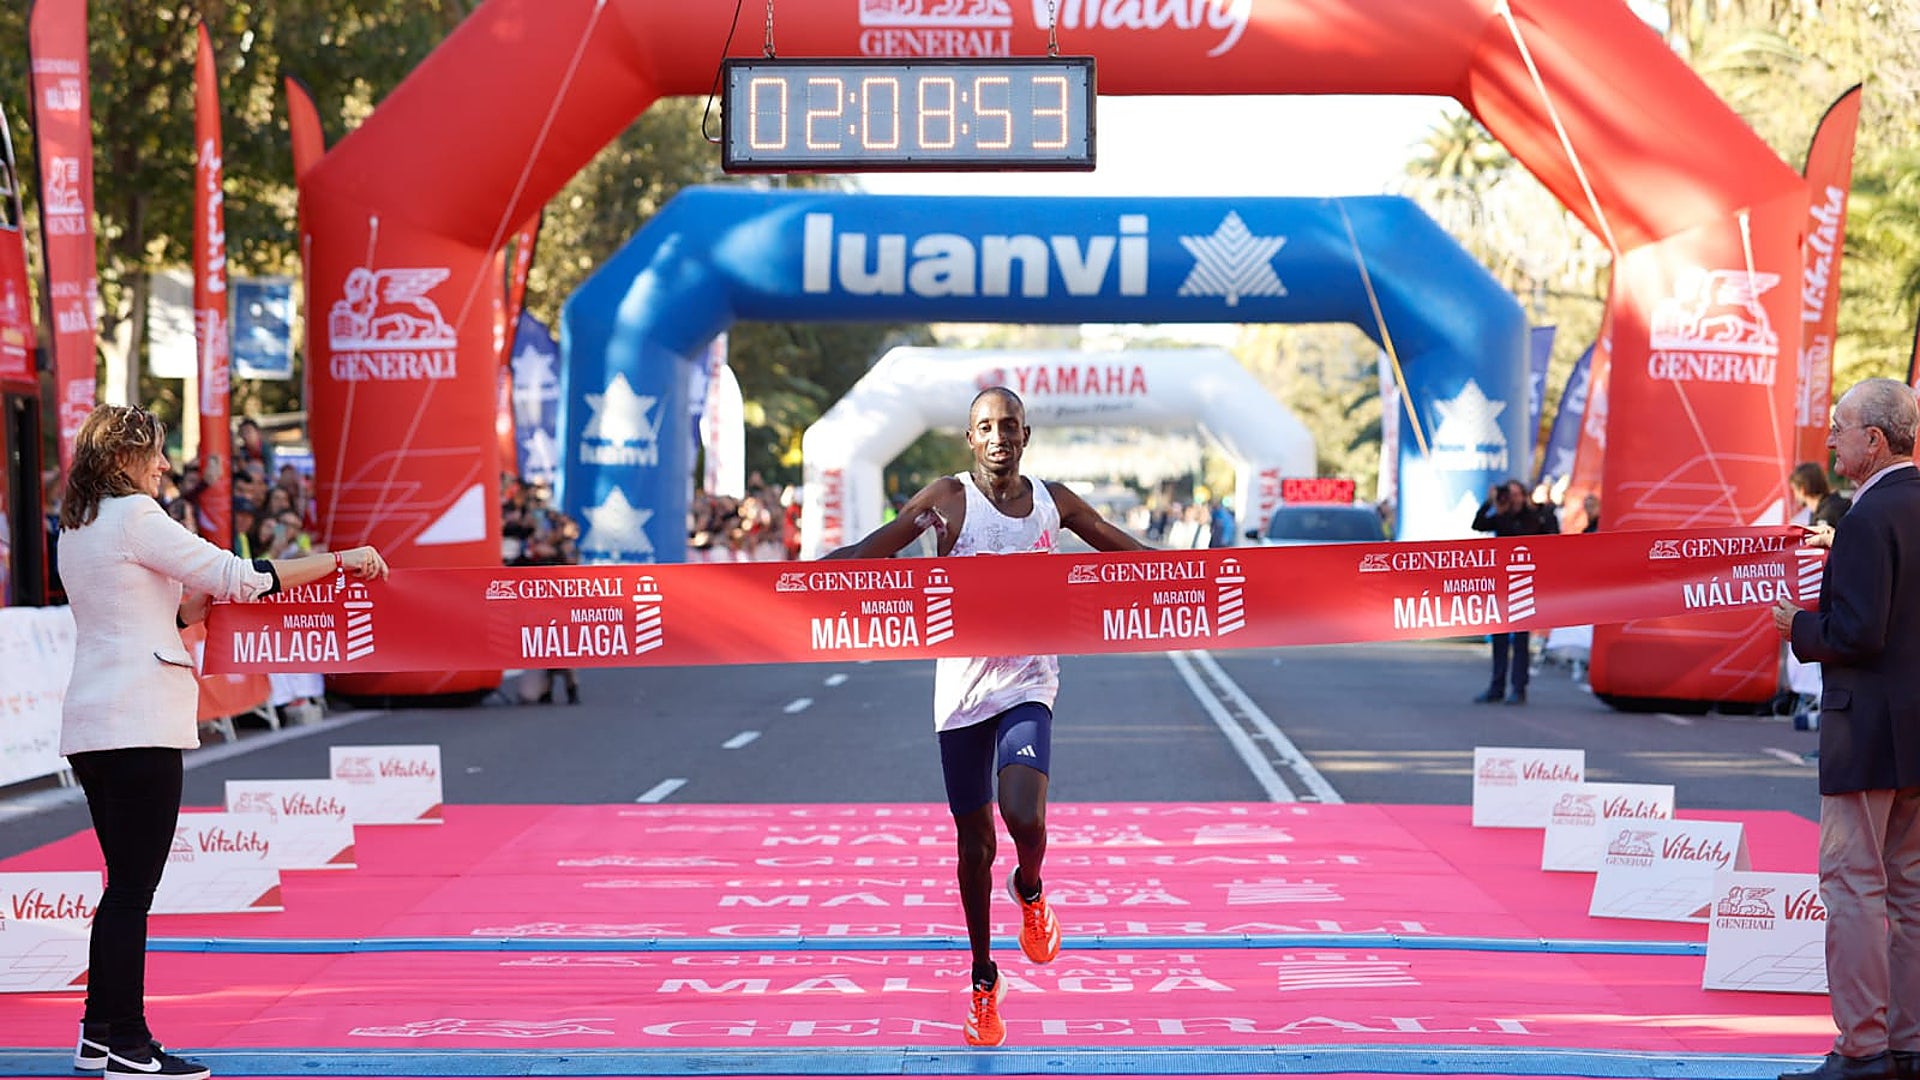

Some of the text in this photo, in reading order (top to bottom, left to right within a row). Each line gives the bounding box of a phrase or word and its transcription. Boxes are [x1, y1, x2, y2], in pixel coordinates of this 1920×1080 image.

[859, 30, 1012, 57] GENERALI
[750, 76, 1068, 150] 02:08:53
[802, 213, 1149, 298] luanvi
[329, 351, 457, 381] GENERALI
[1648, 351, 1778, 384] GENERALI
[1014, 364, 1147, 395] YAMAHA
[1392, 548, 1496, 571] GENERALI
[1682, 535, 1786, 558] GENERALI
[808, 570, 915, 591] GENERALI
[1101, 560, 1207, 583] GENERALI
[1732, 561, 1785, 579] MARATÓN
[252, 584, 335, 604] NERALI
[518, 577, 624, 599] GENERALI
[1152, 588, 1206, 606] MARATÓN
[1443, 576, 1496, 594] MARATÓN
[1683, 576, 1793, 609] MÁLAGA
[570, 605, 624, 624] MARATÓN
[861, 598, 914, 615] MARATÓN
[1393, 590, 1502, 630] MÁLAGA
[283, 612, 335, 629] MARATÓN
[811, 611, 920, 650] MÁLAGA
[1103, 601, 1211, 641] MÁLAGA
[233, 625, 340, 663] MÁLAGA
[521, 619, 630, 658] MÁLAGA
[379, 757, 436, 782] Vitality
[282, 792, 346, 822] Vitality
[198, 825, 269, 861] Vitality
[1662, 832, 1731, 869] Vitality
[12, 887, 98, 930] Vitality
[717, 892, 1191, 907] MÁLGA
[1785, 889, 1829, 922] Vita
[1716, 917, 1776, 931] GENERALI
[672, 953, 1206, 967] GENEALI
[656, 974, 1237, 994] MÁLAGA
